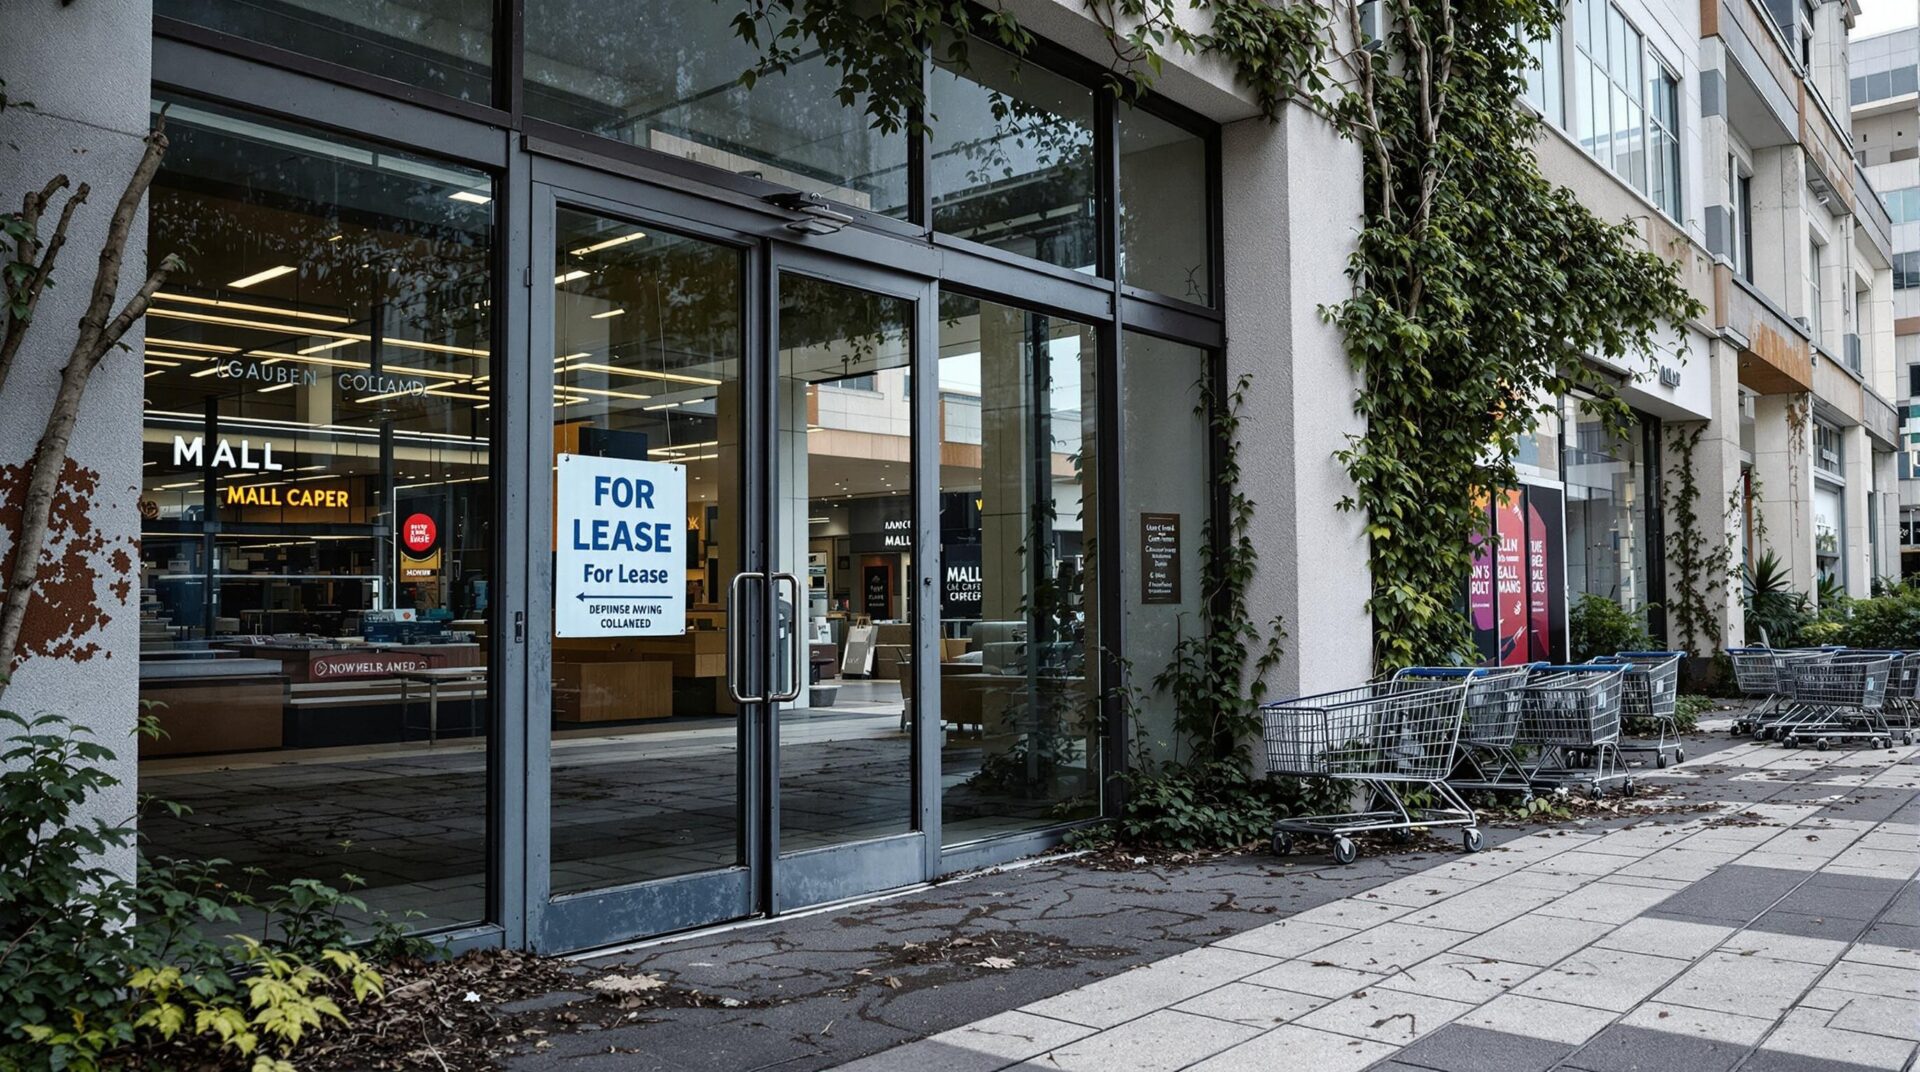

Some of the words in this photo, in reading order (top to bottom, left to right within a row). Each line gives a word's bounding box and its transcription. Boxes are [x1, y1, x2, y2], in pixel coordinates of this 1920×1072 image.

[173, 435, 283, 471] MALL
[227, 485, 282, 506] MALL
[286, 488, 349, 508] CAPER
[594, 475, 655, 509] FOR
[573, 518, 672, 553] LEASE
[884, 535, 912, 547] MALL
[583, 563, 613, 583] For
[618, 564, 668, 583] Lease
[946, 566, 983, 582] MALL
